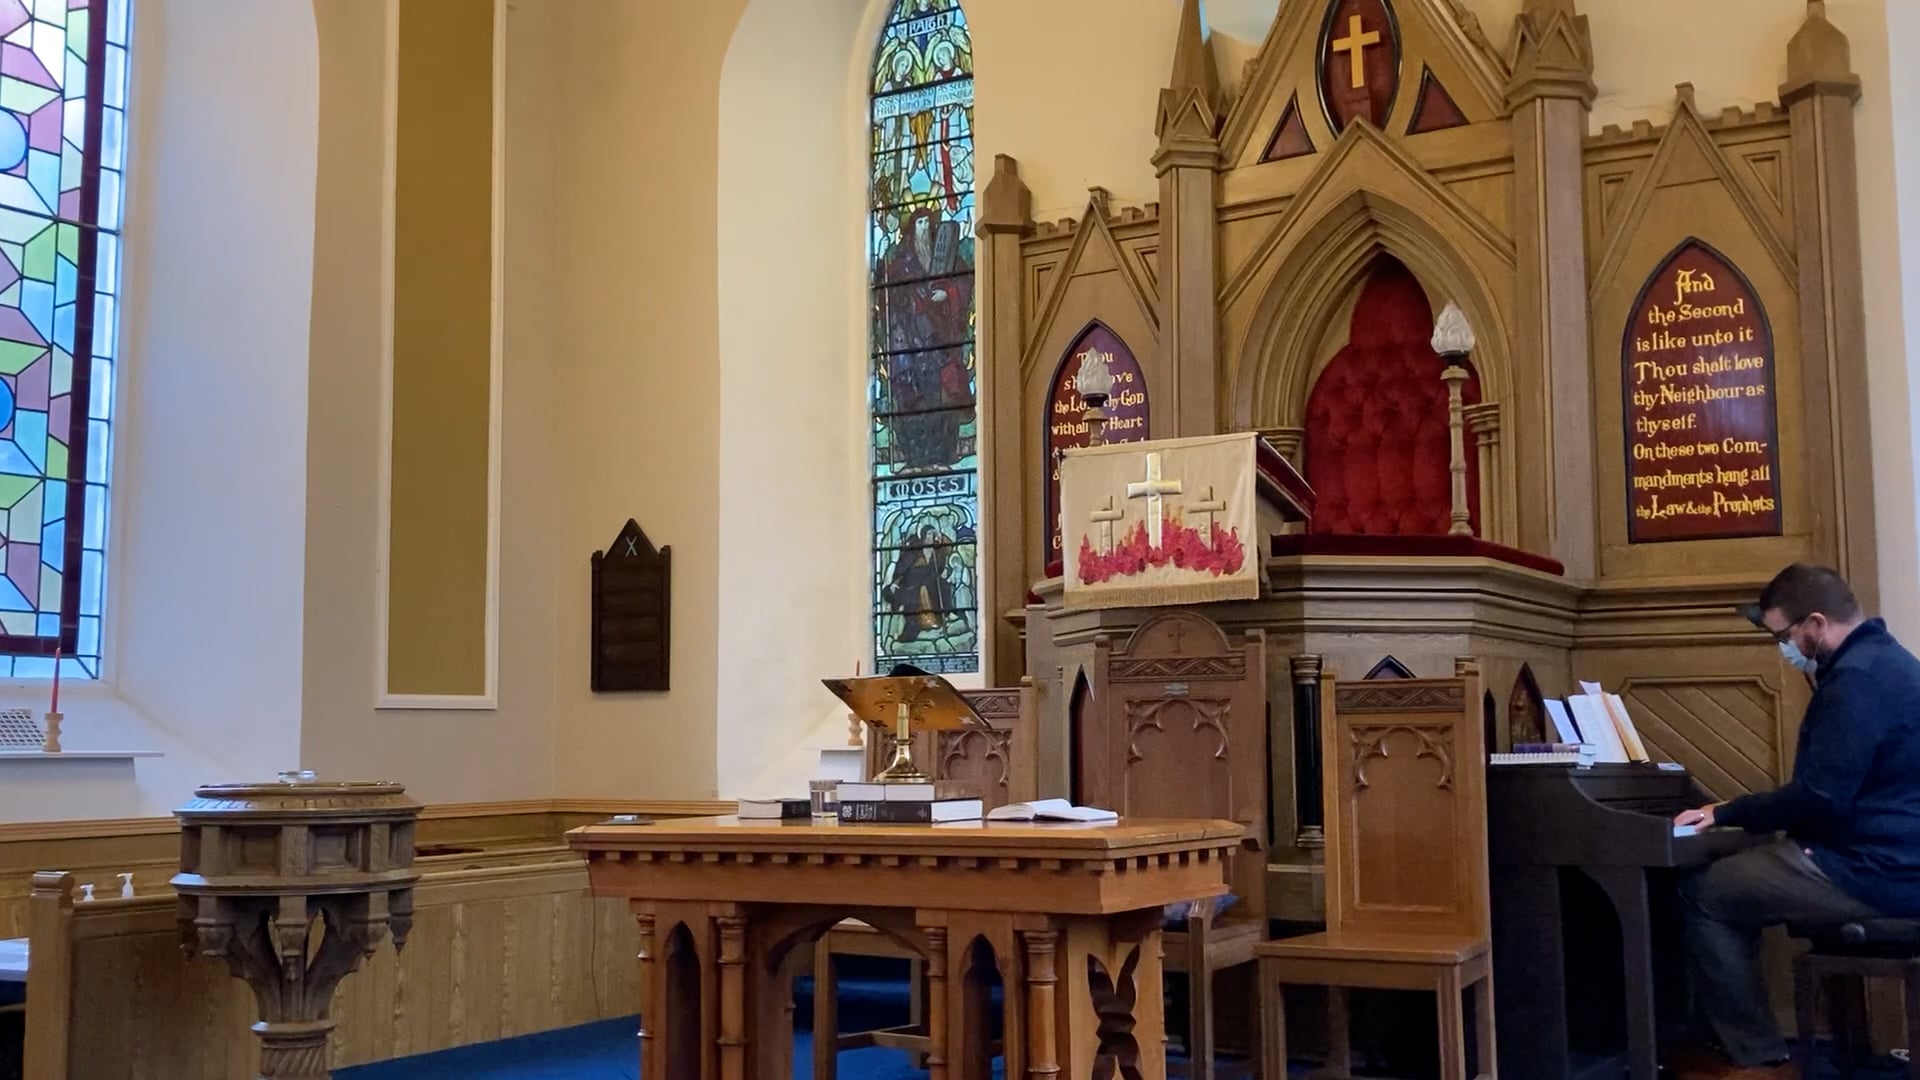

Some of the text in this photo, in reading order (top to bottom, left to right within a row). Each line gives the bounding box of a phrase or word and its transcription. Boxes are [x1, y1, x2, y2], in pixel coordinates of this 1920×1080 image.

[1673, 268, 1715, 305] And
[1648, 298, 1745, 326] the Second
[1636, 326, 1753, 352] is like unto it
[1634, 353, 1764, 384] Thou shalt love
[1054, 400, 1070, 415] the
[1633, 383, 1766, 411] thy Neighbour as
[1051, 421, 1076, 436] with
[1109, 415, 1143, 430] Heart
[1635, 412, 1697, 438] thyself.
[1633, 437, 1768, 461] On these two Com-
[896, 479, 959, 496] MOSES
[1714, 464, 1750, 487] hang
[1750, 463, 1771, 481] all
[1636, 490, 1775, 519] the Law & the Prophets
